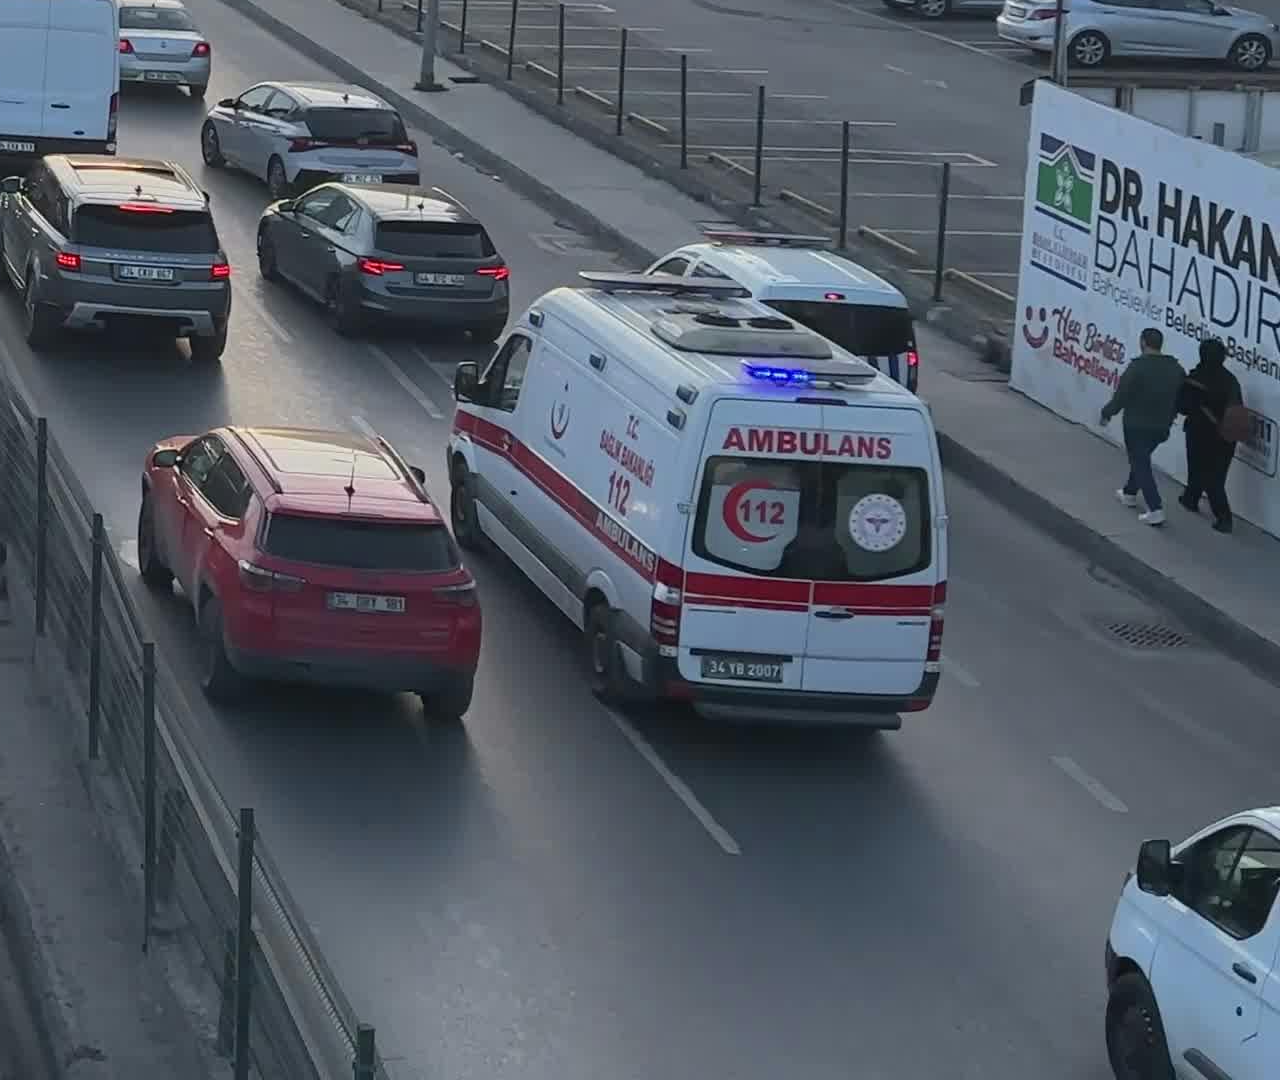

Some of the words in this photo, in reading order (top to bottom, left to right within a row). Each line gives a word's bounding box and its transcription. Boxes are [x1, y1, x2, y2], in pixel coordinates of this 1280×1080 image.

[1099, 158, 1149, 232] DR.
[1156, 180, 1280, 290] HAKAN
[1093, 215, 1280, 354] BAHADIR
[722, 427, 892, 459] AMBULANS
[608, 470, 631, 517] 112
[739, 499, 785, 524] 112
[595, 511, 656, 572] AMBULANS
[710, 661, 726, 673] 34
[748, 663, 780, 677] 2007
